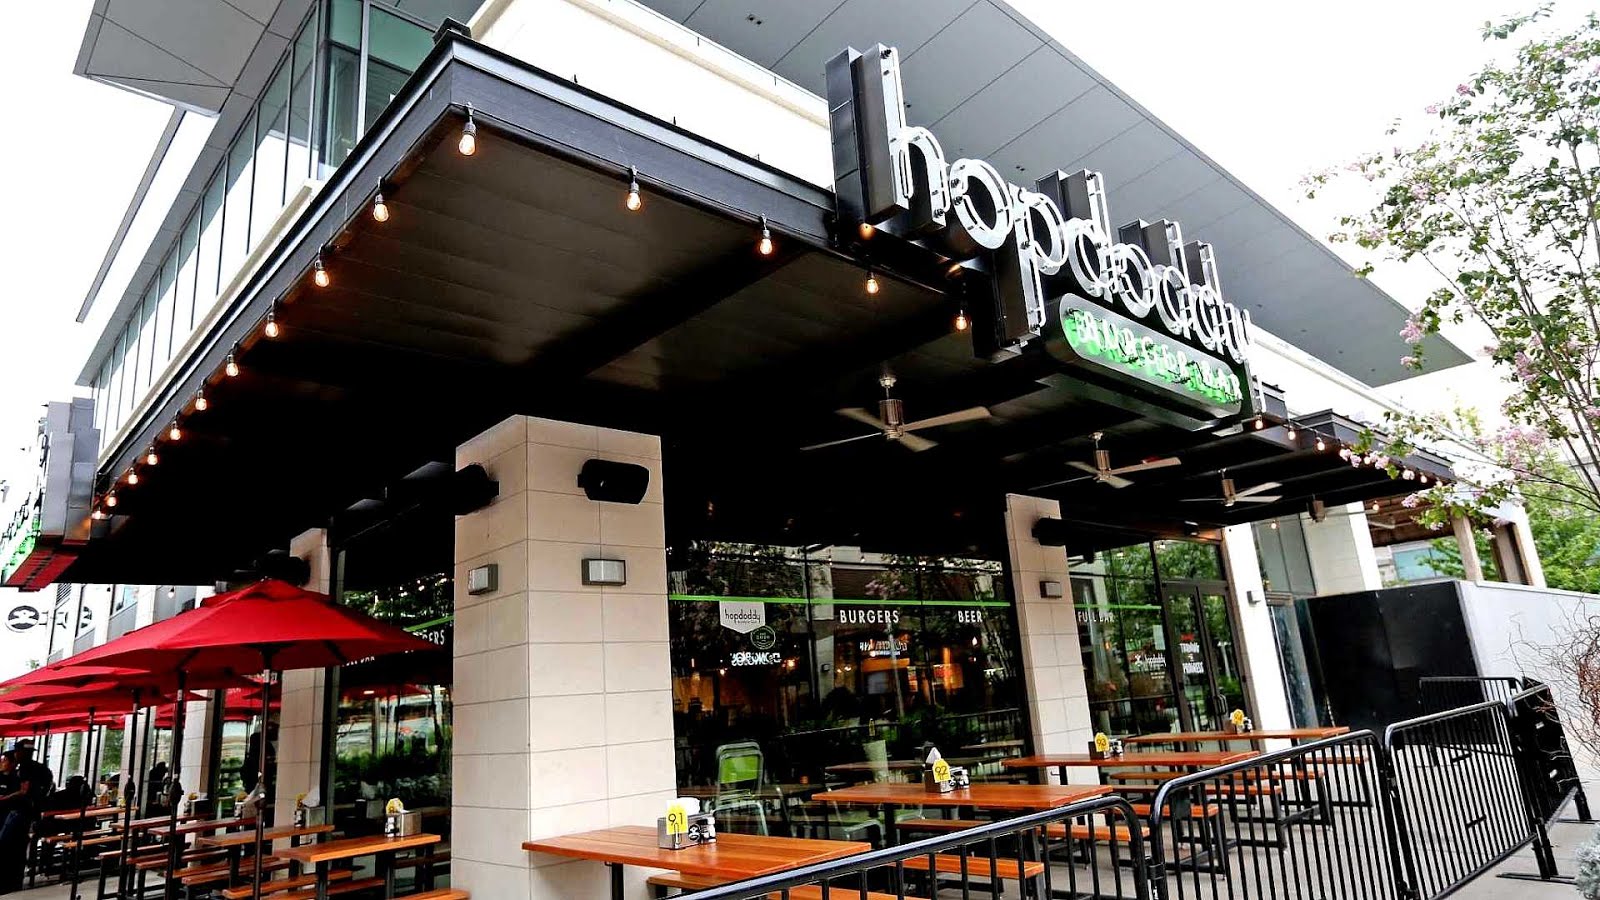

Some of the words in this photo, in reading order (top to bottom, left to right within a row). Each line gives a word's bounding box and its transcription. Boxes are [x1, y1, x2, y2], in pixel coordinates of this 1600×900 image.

[874, 45, 1266, 412] hopdoddy
[725, 608, 760, 623] hopdoddy
[839, 609, 899, 624] BURGERS
[957, 610, 983, 623] BEER
[935, 766, 948, 776] 92
[668, 812, 684, 826] 91
